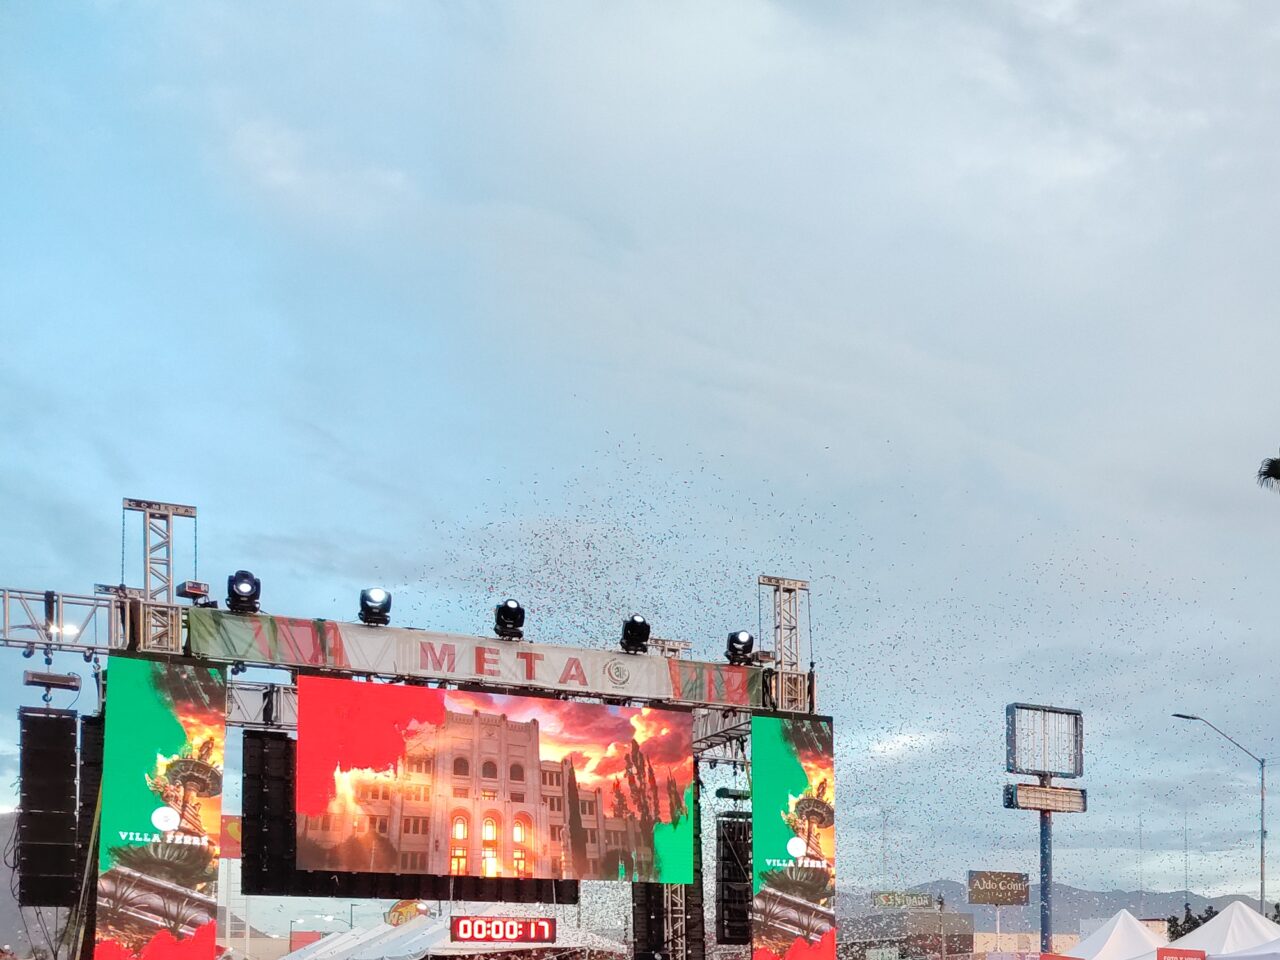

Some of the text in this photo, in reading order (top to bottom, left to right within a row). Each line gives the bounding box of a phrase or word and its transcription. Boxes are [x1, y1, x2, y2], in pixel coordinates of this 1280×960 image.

[419, 641, 589, 686] META
[119, 831, 161, 842] VILLA
[765, 859, 795, 867] VILLA
[973, 878, 997, 890] Aldo
[459, 919, 549, 940] 00:00:17
